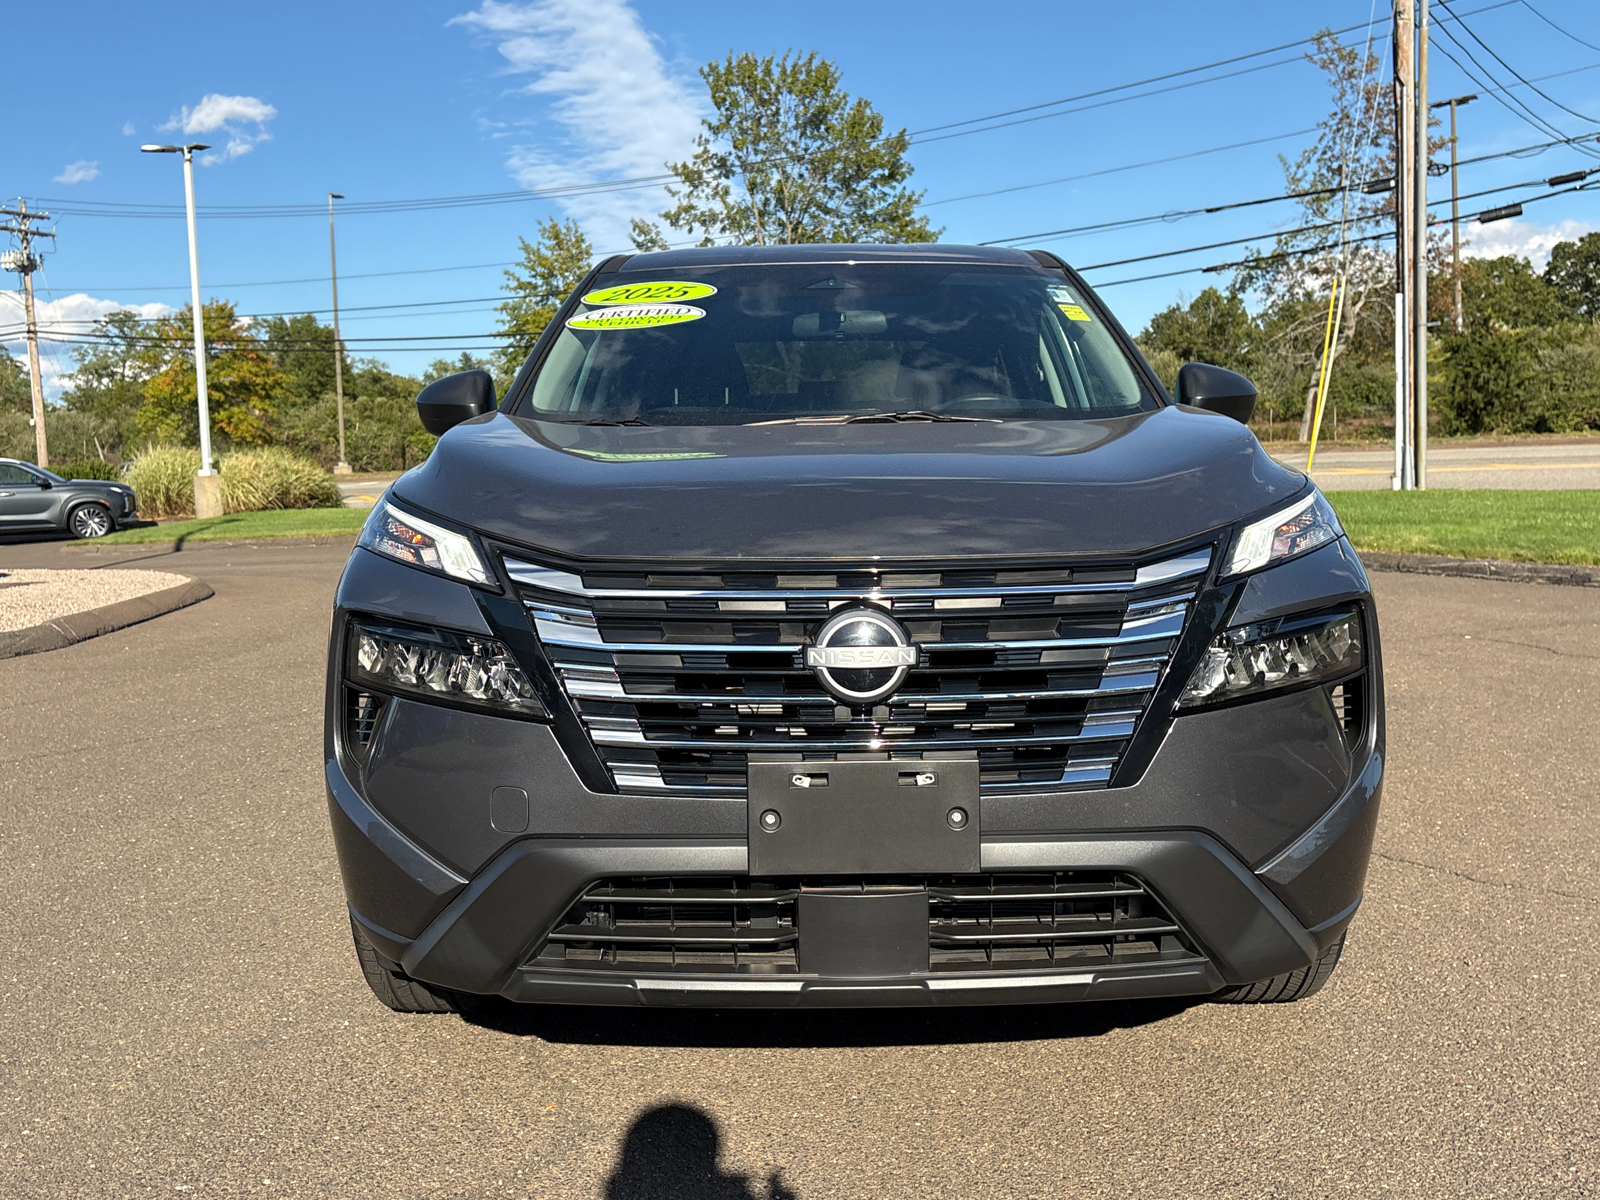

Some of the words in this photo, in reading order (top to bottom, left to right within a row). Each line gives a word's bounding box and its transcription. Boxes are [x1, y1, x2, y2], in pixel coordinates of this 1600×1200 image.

[600, 285, 698, 302] 2025
[585, 307, 691, 321] CERTIFIED
[809, 649, 914, 665] NISSAN
